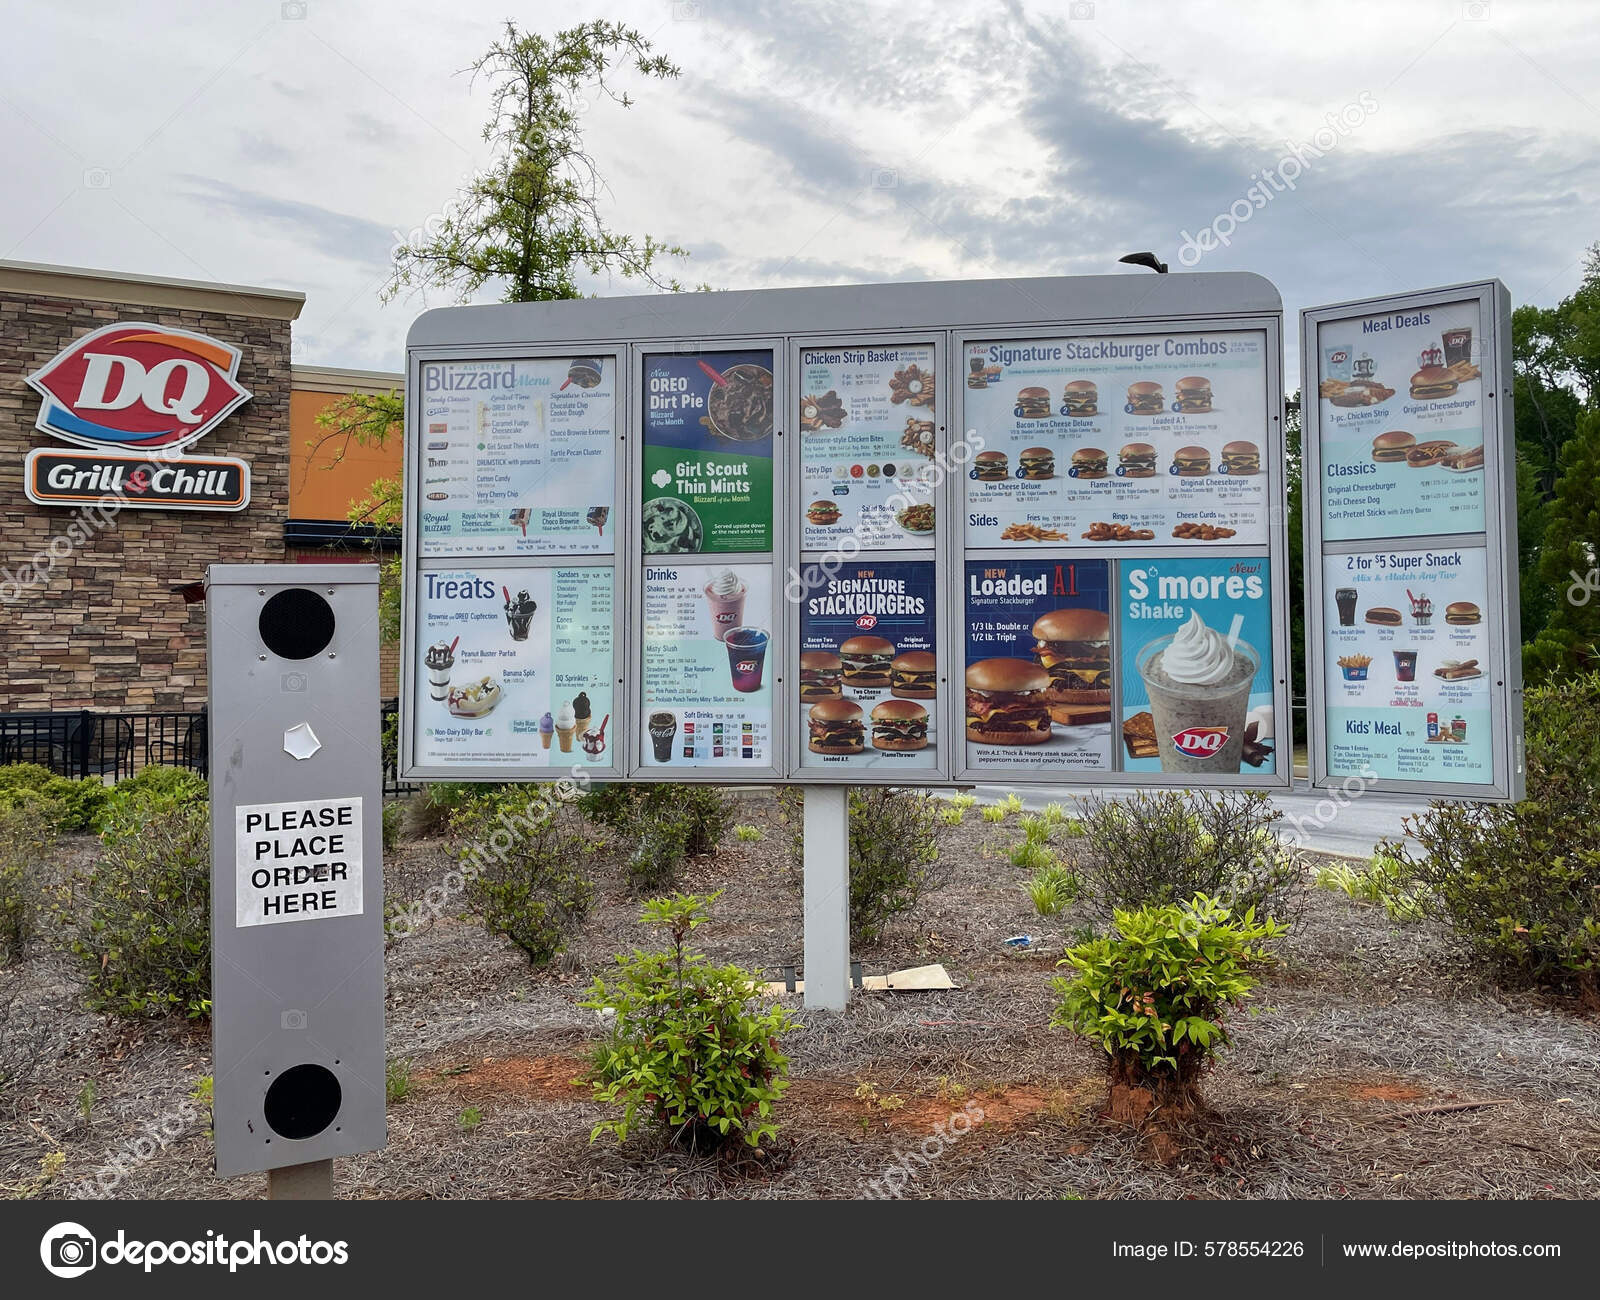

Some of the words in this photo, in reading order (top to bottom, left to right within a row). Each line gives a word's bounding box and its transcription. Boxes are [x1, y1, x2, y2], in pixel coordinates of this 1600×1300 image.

[1362, 316, 1393, 334] Meal
[1395, 312, 1431, 329] Deals
[804, 351, 841, 366] Chicken
[843, 351, 865, 366] Strip
[867, 349, 899, 363] Basket
[989, 344, 1061, 367] Signature
[1066, 341, 1160, 361] Stackburger
[1164, 337, 1228, 356] Combos
[425, 364, 515, 392] Blizzard
[650, 368, 670, 378] New
[73, 352, 211, 424] DQ
[650, 377, 688, 393] OREO
[650, 393, 678, 410] Dirt
[681, 392, 704, 409] Pie
[1403, 404, 1429, 415] Original
[1429, 400, 1476, 411] Cheeseburger
[650, 410, 674, 419] Blizzard
[1152, 416, 1175, 425] Loaded
[1347, 410, 1373, 421] Chicken
[1373, 409, 1390, 419] Strip
[665, 418, 684, 426] Month
[1016, 421, 1035, 429] Bacon
[1049, 420, 1071, 428] Cheese
[1072, 419, 1094, 427] Deluxe
[847, 435, 870, 444] Chicken
[870, 434, 884, 442] Bites
[675, 461, 702, 477] Girl
[705, 461, 749, 477] Scout
[805, 465, 820, 474] Tasty
[820, 465, 833, 474] Dips
[1219, 465, 1228, 473] 10
[1327, 460, 1377, 477] Classics
[47, 464, 124, 491] Grill
[123, 470, 151, 493] &
[151, 467, 229, 496] Chill
[675, 478, 707, 494] Thin
[710, 477, 750, 493] Mints
[1090, 481, 1134, 489] FlameThrower
[1180, 479, 1205, 488] Original
[1205, 479, 1249, 487] Cheeseburger
[984, 483, 997, 491] Two
[997, 482, 1020, 490] Cheese
[1020, 482, 1041, 490] Deluxe
[1327, 486, 1352, 496] Original
[1352, 481, 1397, 493] Cheeseburger
[1328, 498, 1343, 507] Chili
[1343, 497, 1367, 506] Cheese
[1367, 496, 1381, 505] Dog
[423, 512, 449, 524] Royal
[969, 513, 999, 527] Sides
[1112, 512, 1129, 521] Rings
[1176, 511, 1199, 519] Cheese
[1199, 511, 1217, 519] Curds
[1328, 510, 1342, 520] Soft
[1342, 509, 1366, 519] Pretzel
[1366, 508, 1386, 517] Sticks
[804, 527, 827, 535] Chicken
[827, 527, 854, 535] Sandwich
[1229, 562, 1262, 574] New!
[1346, 556, 1354, 570] 2
[1356, 555, 1373, 570] for
[1375, 554, 1386, 569] $5
[1389, 554, 1423, 572] Super
[1425, 552, 1462, 567] Snack
[646, 568, 678, 581] Drinks
[857, 570, 875, 579] NEW
[984, 568, 1007, 579] NEW
[1352, 574, 1372, 583] Mix
[1384, 572, 1417, 582] Match
[1418, 571, 1437, 583] Any
[1438, 570, 1457, 580] Two
[423, 573, 496, 600] Treats
[646, 585, 666, 593] Shakes
[827, 579, 905, 595] SIGNATURE
[970, 574, 1047, 596] Loaded
[808, 593, 925, 616] STACKBURGERS
[970, 597, 998, 606] Signature
[999, 597, 1035, 606] Stackburger
[1129, 601, 1185, 620] Shake
[859, 618, 874, 627] DQ
[971, 622, 984, 631] 1/3
[985, 622, 995, 631] lb.
[996, 622, 1021, 631] Double
[971, 633, 984, 642] 1/2
[985, 633, 995, 641] lb.
[996, 633, 1017, 643] Triple
[896, 642, 931, 650] Cheeseburger
[498, 649, 517, 657] Parfait
[739, 661, 757, 671] DQ
[502, 669, 522, 677] Banana
[522, 669, 536, 677] Split
[683, 711, 696, 719] Soft
[696, 711, 714, 719] Drinks
[461, 728, 473, 736] Dilly
[1346, 719, 1372, 735] Kids'
[1374, 721, 1402, 736] Meal
[1181, 733, 1222, 751] DQ
[246, 806, 353, 833] PLEASE
[255, 834, 344, 861] PLACE
[251, 861, 348, 889] ORDER
[263, 890, 337, 916] HERE
